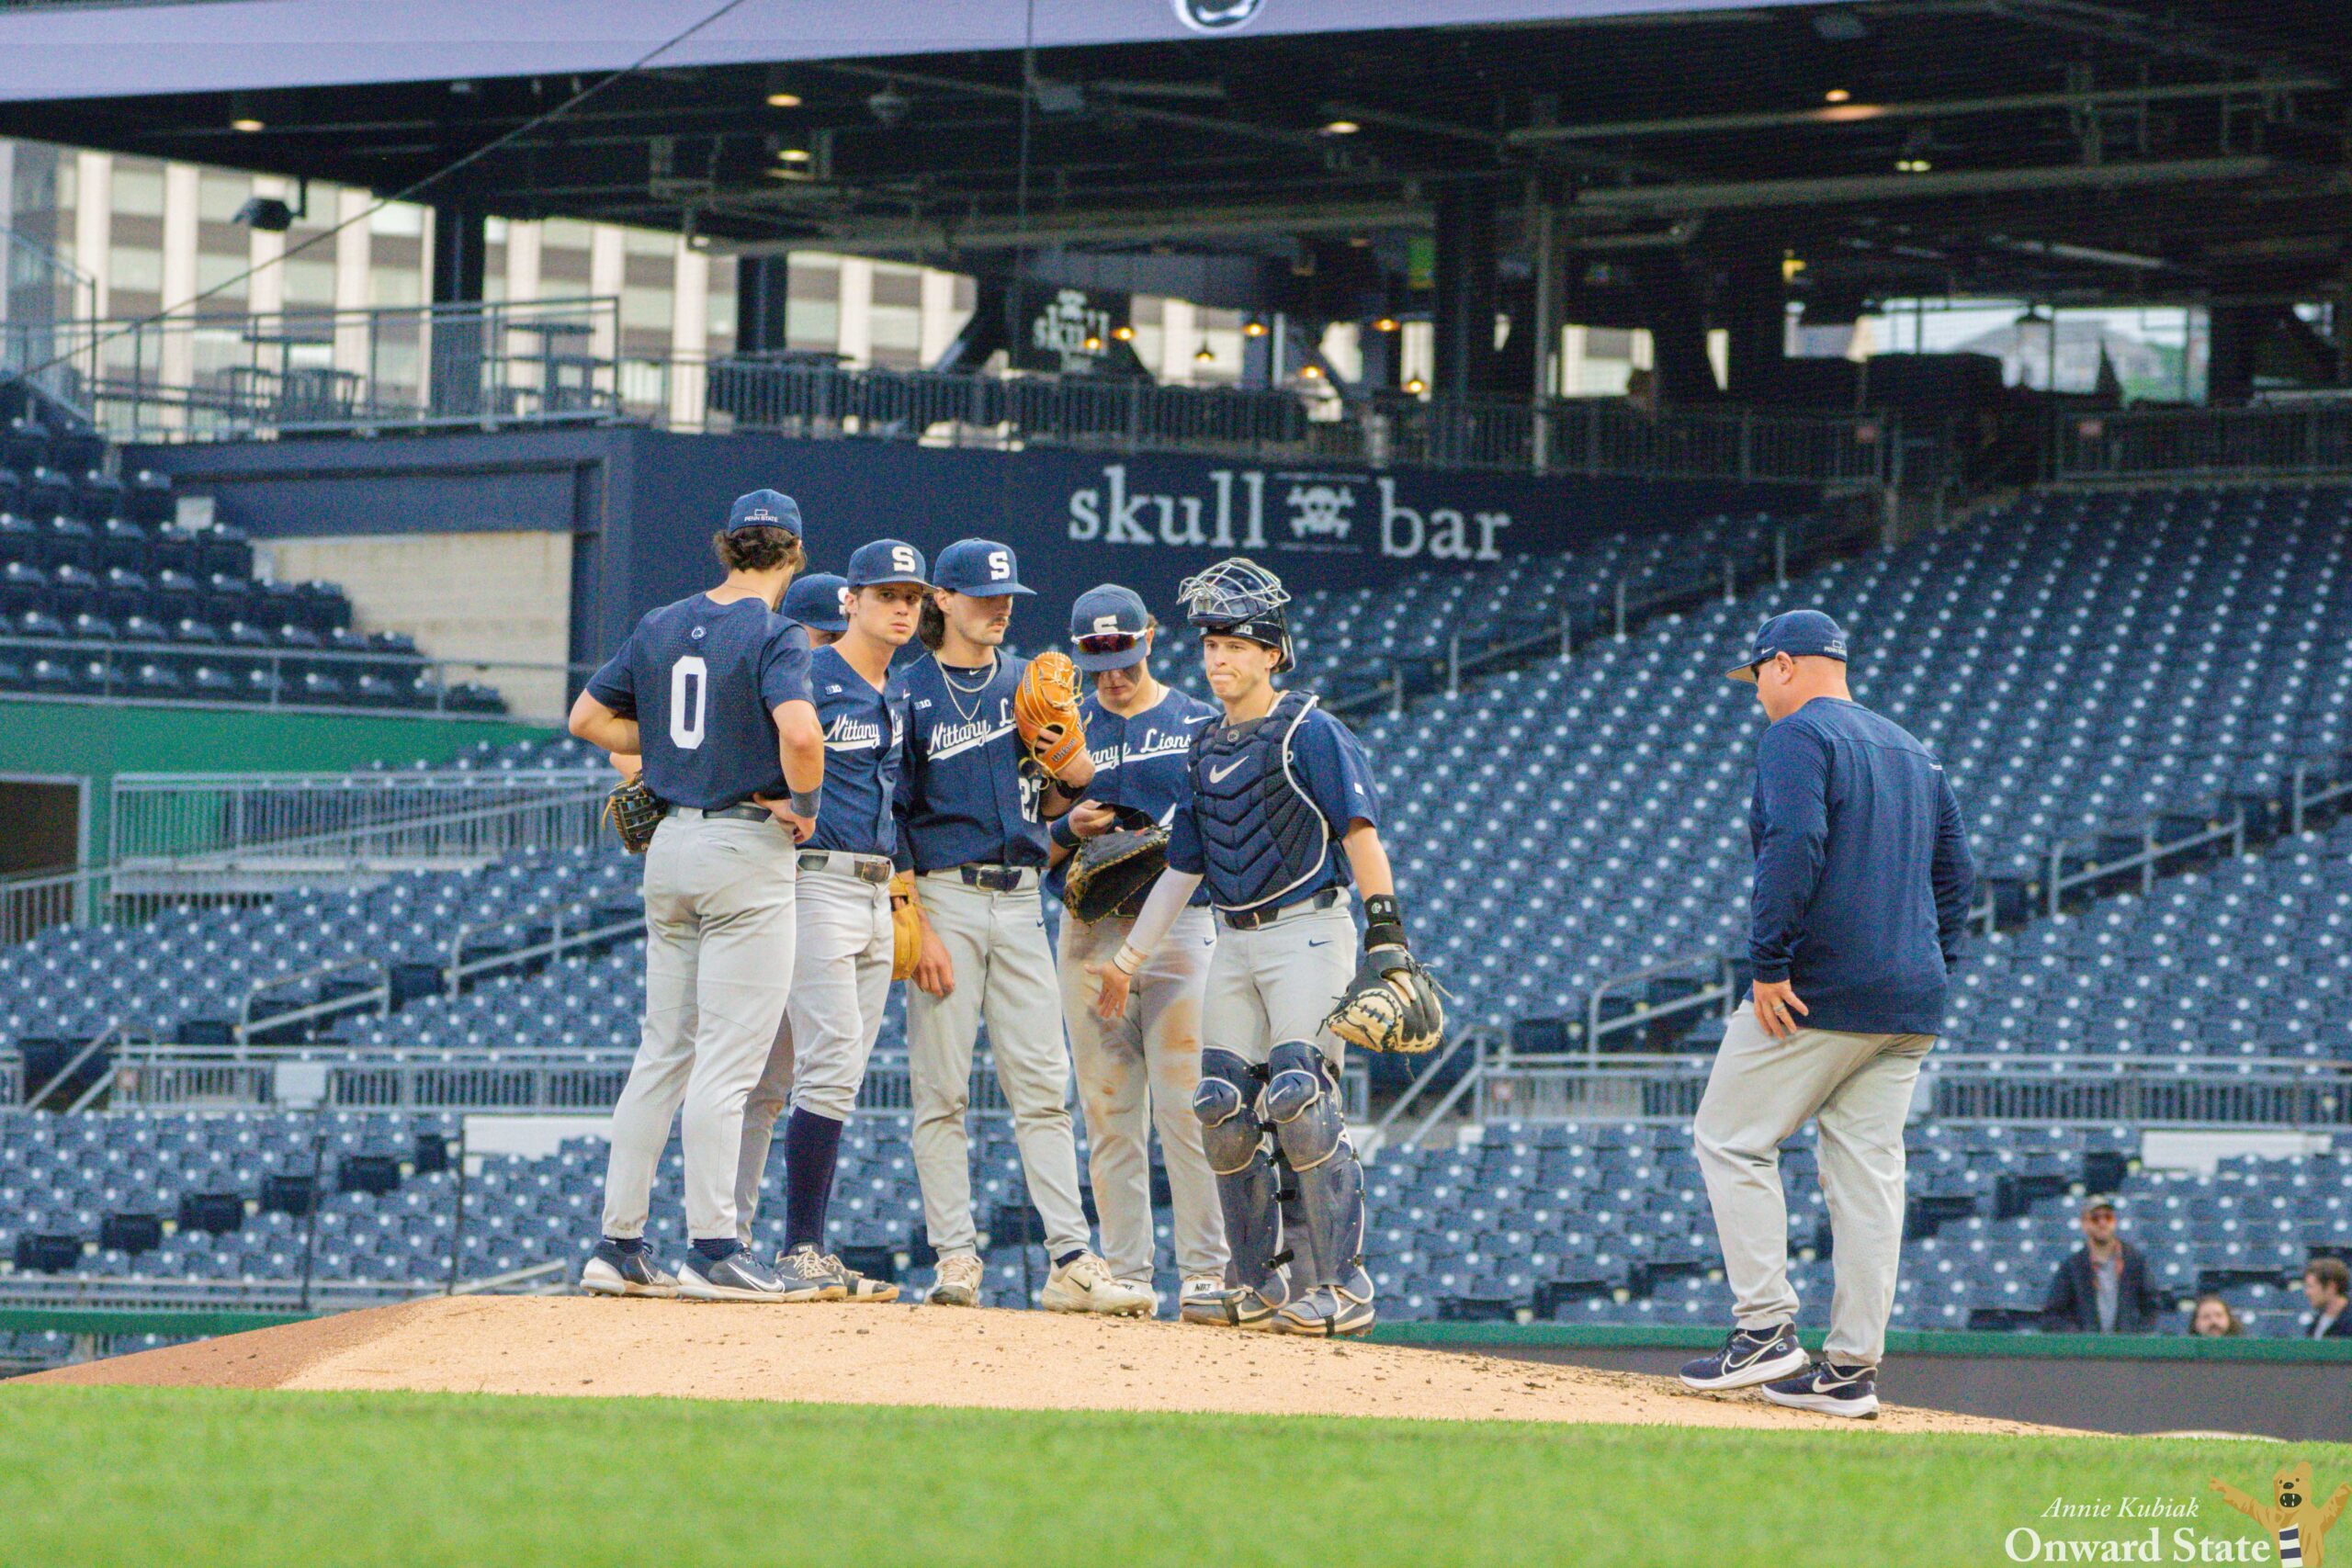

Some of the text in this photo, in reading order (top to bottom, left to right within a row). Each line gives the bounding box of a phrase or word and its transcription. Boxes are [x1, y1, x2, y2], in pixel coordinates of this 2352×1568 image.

[1068, 464, 1511, 561] skull bar
[891, 546, 916, 573] S
[988, 551, 1012, 581] S
[670, 655, 707, 750] 0
[823, 714, 881, 750] Nittany
[926, 719, 991, 755] Nittany
[1050, 738, 1078, 763] Wilson
[1019, 777, 1043, 823] 27
[797, 1245, 813, 1253] NIKE
[1193, 1283, 1212, 1292] NIKE
